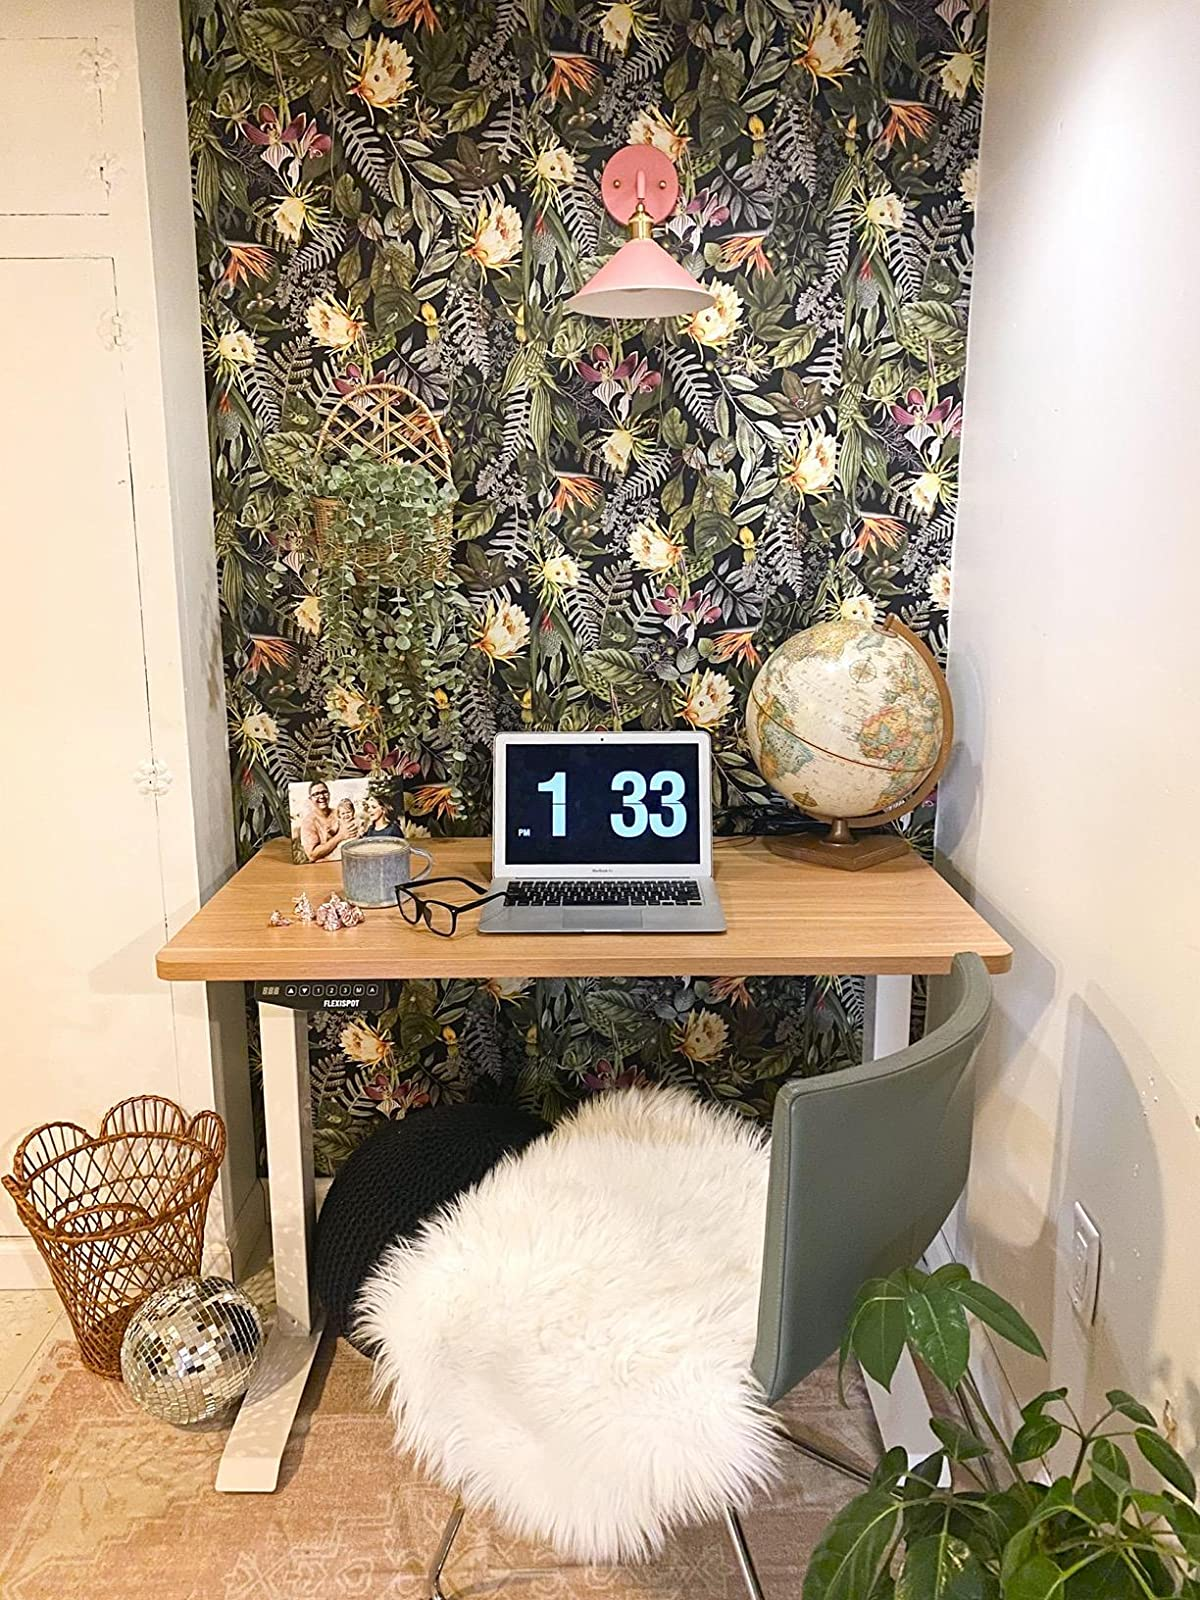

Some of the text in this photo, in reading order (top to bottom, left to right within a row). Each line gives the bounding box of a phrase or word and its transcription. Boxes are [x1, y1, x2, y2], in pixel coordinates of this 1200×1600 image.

[517, 770, 687, 838] PM 1 33
[323, 999, 360, 1007] FLEXISPOT
